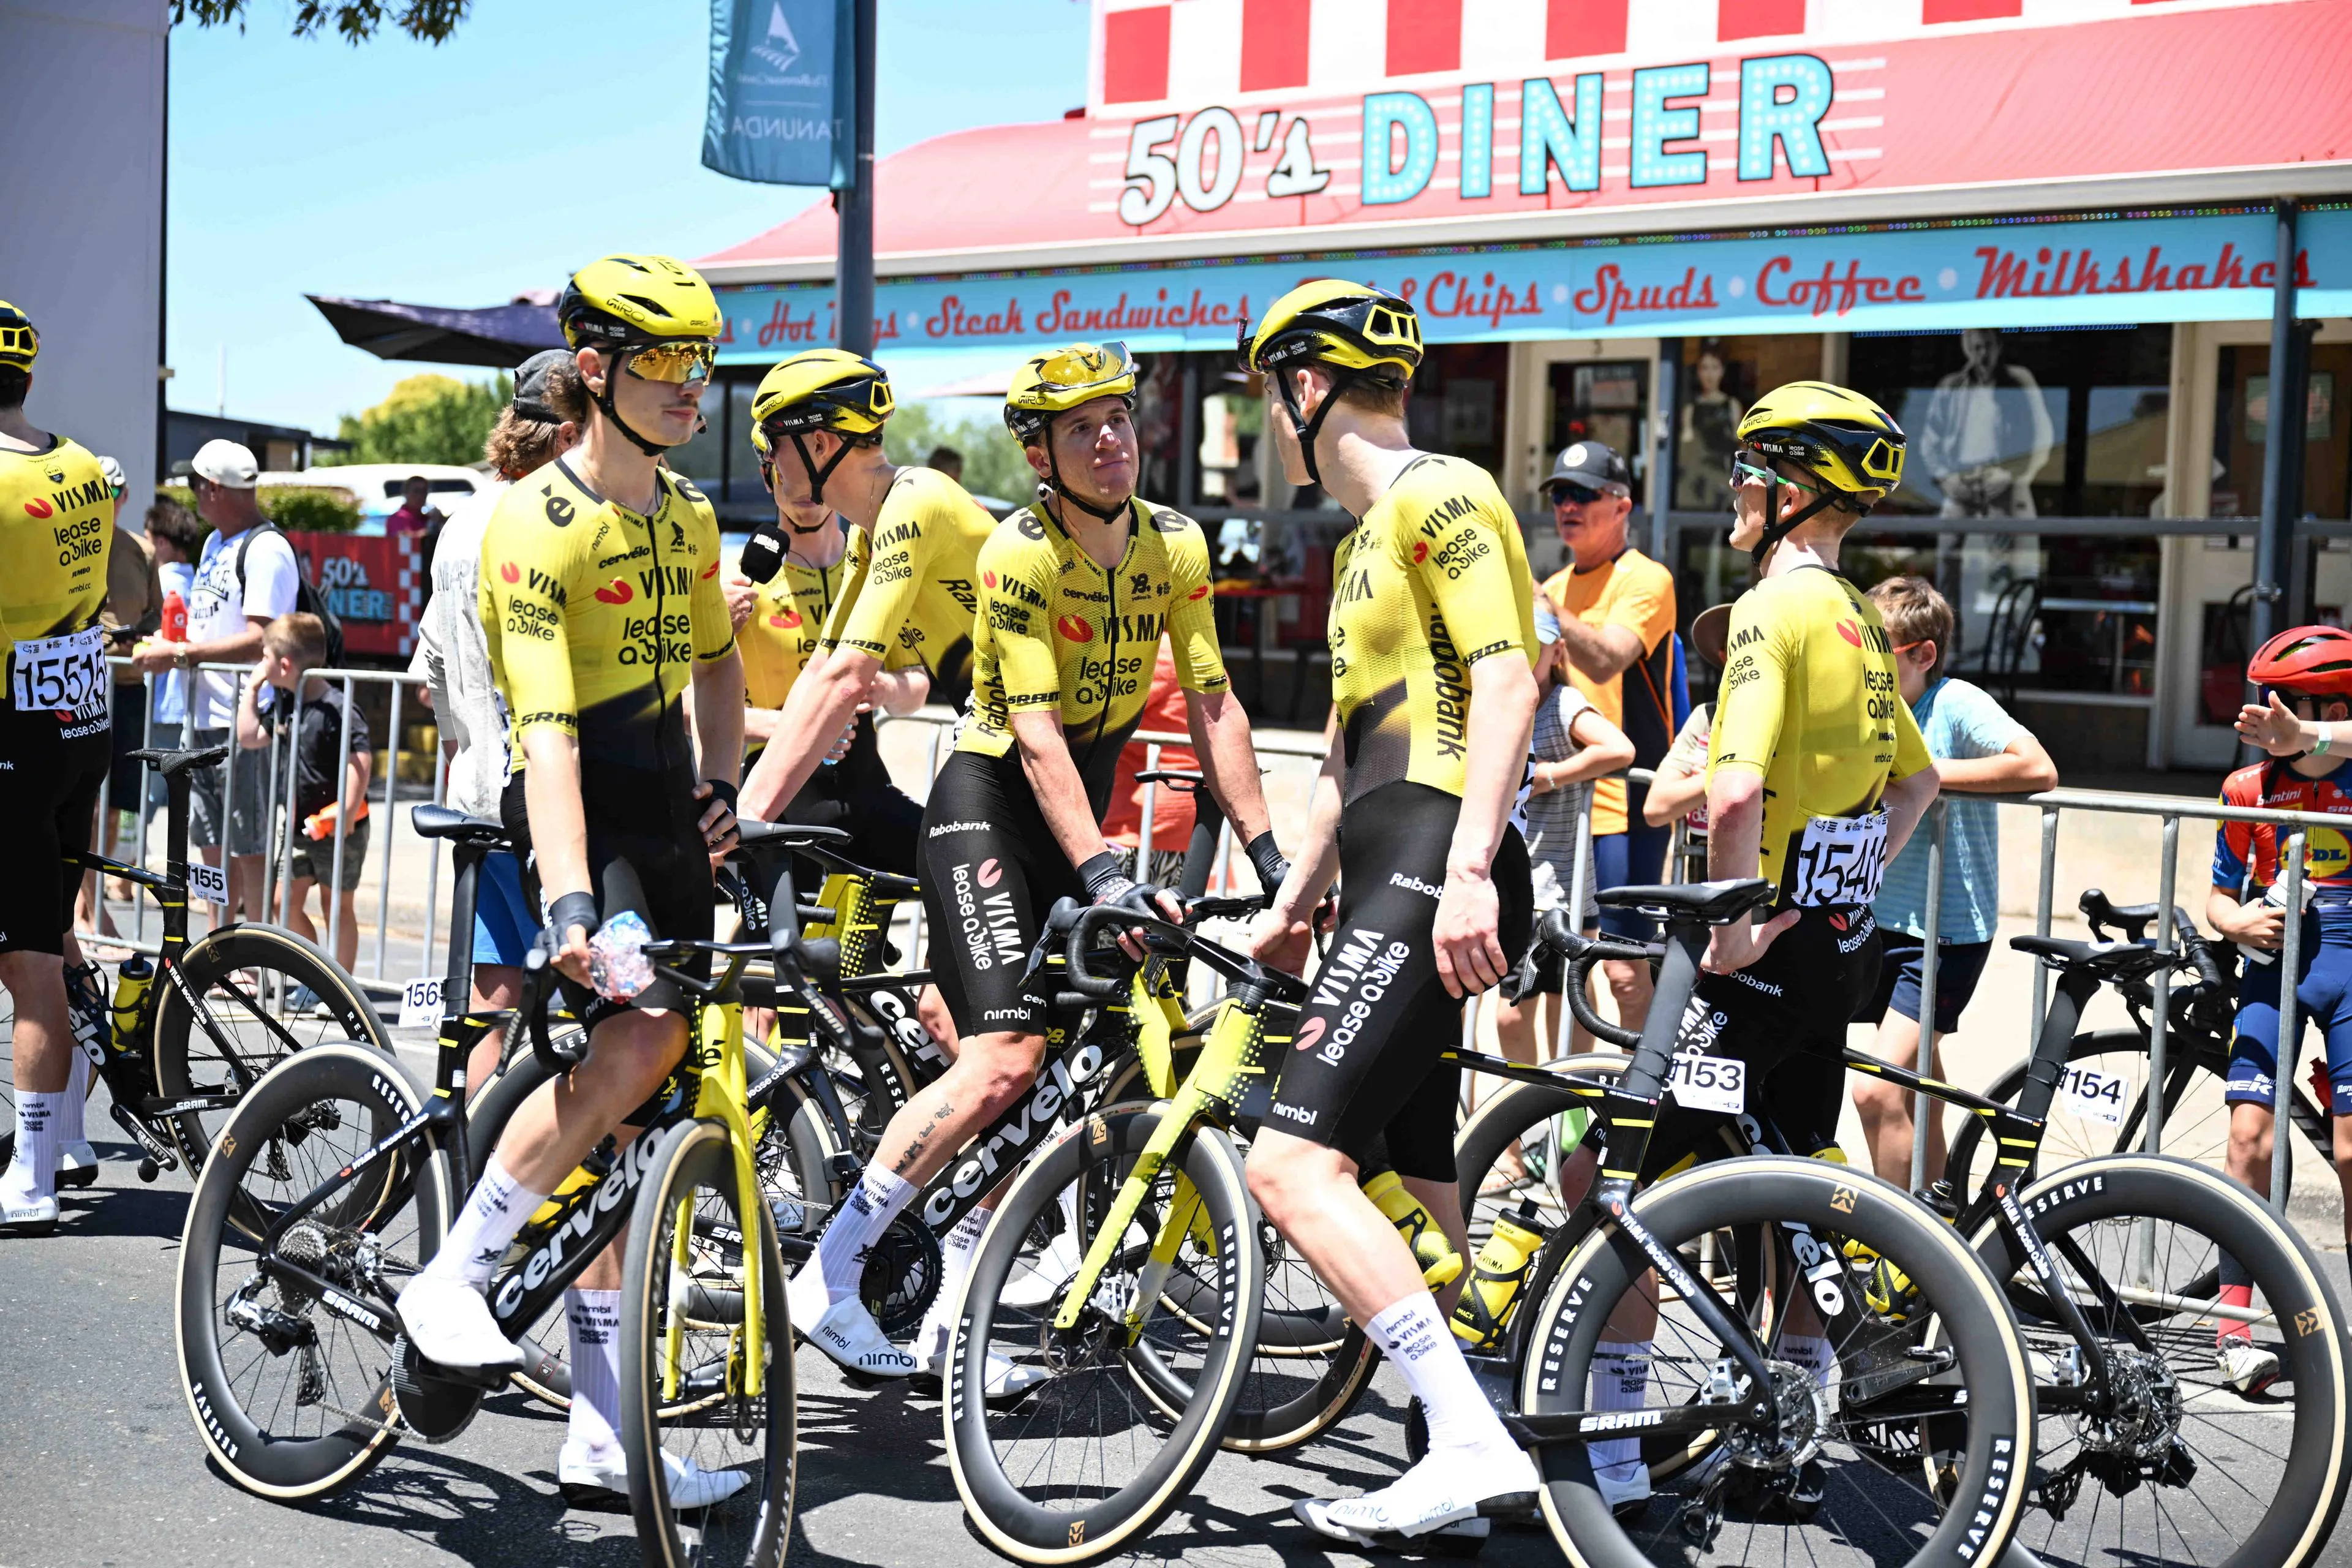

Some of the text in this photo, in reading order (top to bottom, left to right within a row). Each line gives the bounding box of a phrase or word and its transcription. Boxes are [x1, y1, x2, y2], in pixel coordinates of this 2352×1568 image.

[1120, 53, 1834, 225] 50's DINER
[758, 299, 817, 347] Hot
[925, 294, 1025, 338] Steak
[1036, 287, 1253, 334] Sandwiches
[1424, 271, 1544, 329] Chips
[1574, 263, 1719, 325] Spuds
[1755, 255, 1926, 317] Coffee
[1974, 243, 2318, 299] Milkshakes
[606, 298, 645, 323] GIRO
[1268, 350, 1288, 364] VISMA
[1289, 341, 1305, 350] lease
[760, 395, 784, 415] GIRO
[1018, 395, 1046, 405] GIRO
[783, 417, 804, 427] VISMA
[1762, 442, 1784, 454] VISMA
[51, 477, 113, 513] VISMA
[623, 513, 644, 529] VISMA
[1420, 494, 1479, 541] VISMA
[54, 518, 100, 546] lease
[592, 521, 611, 551] nimbl
[874, 521, 922, 551] VISMA
[598, 545, 650, 569] cervélo
[1433, 527, 1478, 570] lease
[72, 567, 90, 578] JUMBO
[873, 551, 910, 574] lease
[1059, 557, 1077, 576] nimbl
[1084, 558, 1102, 577] VISMA
[1117, 559, 1131, 576] lease
[69, 582, 91, 595] nimbl.cc
[1002, 574, 1048, 611] VISMA
[1063, 587, 1109, 603] cervélo
[328, 588, 390, 621] NER
[508, 594, 559, 626] lease
[990, 597, 1031, 621] lease
[623, 613, 690, 641] lease
[1102, 614, 1164, 644] VISMA
[1079, 657, 1142, 680] lease
[1863, 664, 1894, 693] lease
[1008, 691, 1060, 705] SRAM
[61, 725, 89, 739] lease
[1874, 754, 1893, 764] nimbl.cc
[929, 821, 991, 839] Rabobank
[191, 867, 224, 891] 155
[952, 862, 976, 917] lease
[982, 891, 1025, 966] VISMA
[1839, 933, 1862, 954] lease
[1311, 928, 1384, 1006] VISMA
[168, 965, 183, 988] VISMA
[181, 985, 195, 1007] lease
[405, 981, 438, 1008] 156
[1729, 970, 1784, 997] bobank
[801, 988, 846, 1035] SRAM
[984, 1006, 1031, 1020] nimbl
[1316, 1001, 1371, 1067] lease
[1678, 1060, 1741, 1091] 153
[2070, 1069, 2121, 1105] 154
[746, 1078, 772, 1099] lease
[2226, 1080, 2274, 1096] REK
[176, 1099, 208, 1111] SRAM
[1273, 1101, 1318, 1125] nimbl
[129, 1121, 168, 1159] SRAM
[924, 1044, 1104, 1227] cervélo
[869, 1175, 892, 1194] nimbl
[854, 1193, 874, 1210] lease
[864, 1186, 889, 1208] VISMA
[2024, 1176, 2103, 1221] ESERVE
[2000, 1194, 2021, 1225] VISMA
[496, 1125, 667, 1319] cervélo
[956, 1224, 981, 1238] VISMA
[1620, 1212, 1648, 1244] VISMA
[1645, 1241, 1672, 1272] lease
[1482, 1256, 1503, 1272] VISMA
[1223, 1224, 1236, 1336] RESERVE
[322, 1289, 380, 1330] SRAM
[576, 1305, 611, 1314] nimbl
[1385, 1309, 1417, 1334] nimbl
[579, 1328, 609, 1338] lease
[584, 1316, 620, 1328] VISMA
[1399, 1317, 1433, 1341] VISMA
[1542, 1276, 1593, 1390] RESERVE
[823, 1325, 851, 1350] nimbl
[1402, 1333, 1433, 1355] lease
[859, 1352, 918, 1368] nimbl
[1784, 1346, 1812, 1355] nimbl
[952, 1317, 971, 1422] RESERVE
[194, 1381, 239, 1460] RESERVE
[1580, 1410, 1661, 1432] SRAM
[1958, 1439, 2011, 1561] RESERVE
